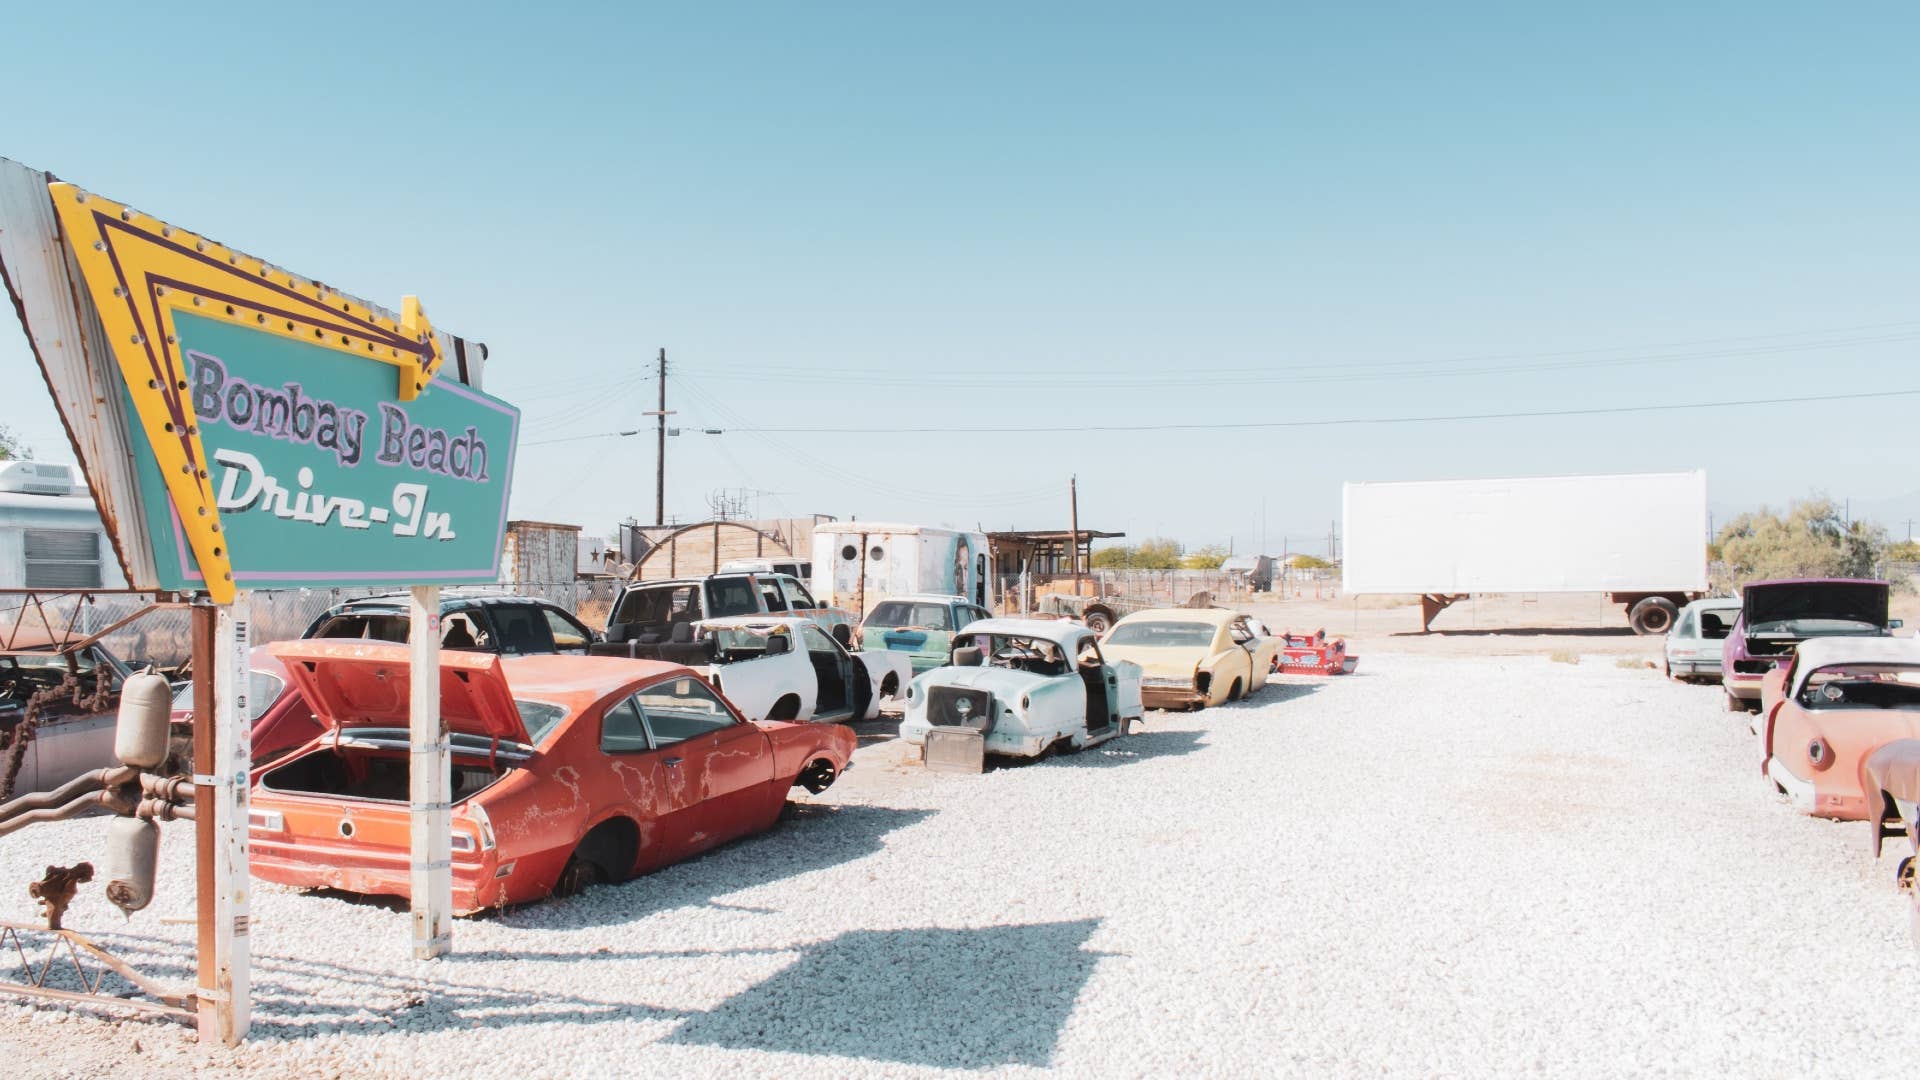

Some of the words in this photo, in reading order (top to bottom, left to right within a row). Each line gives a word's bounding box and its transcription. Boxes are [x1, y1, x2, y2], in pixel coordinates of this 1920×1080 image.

[188, 351, 367, 466] Bombay
[376, 402, 488, 483] Beach
[214, 448, 456, 541] Drive-In
